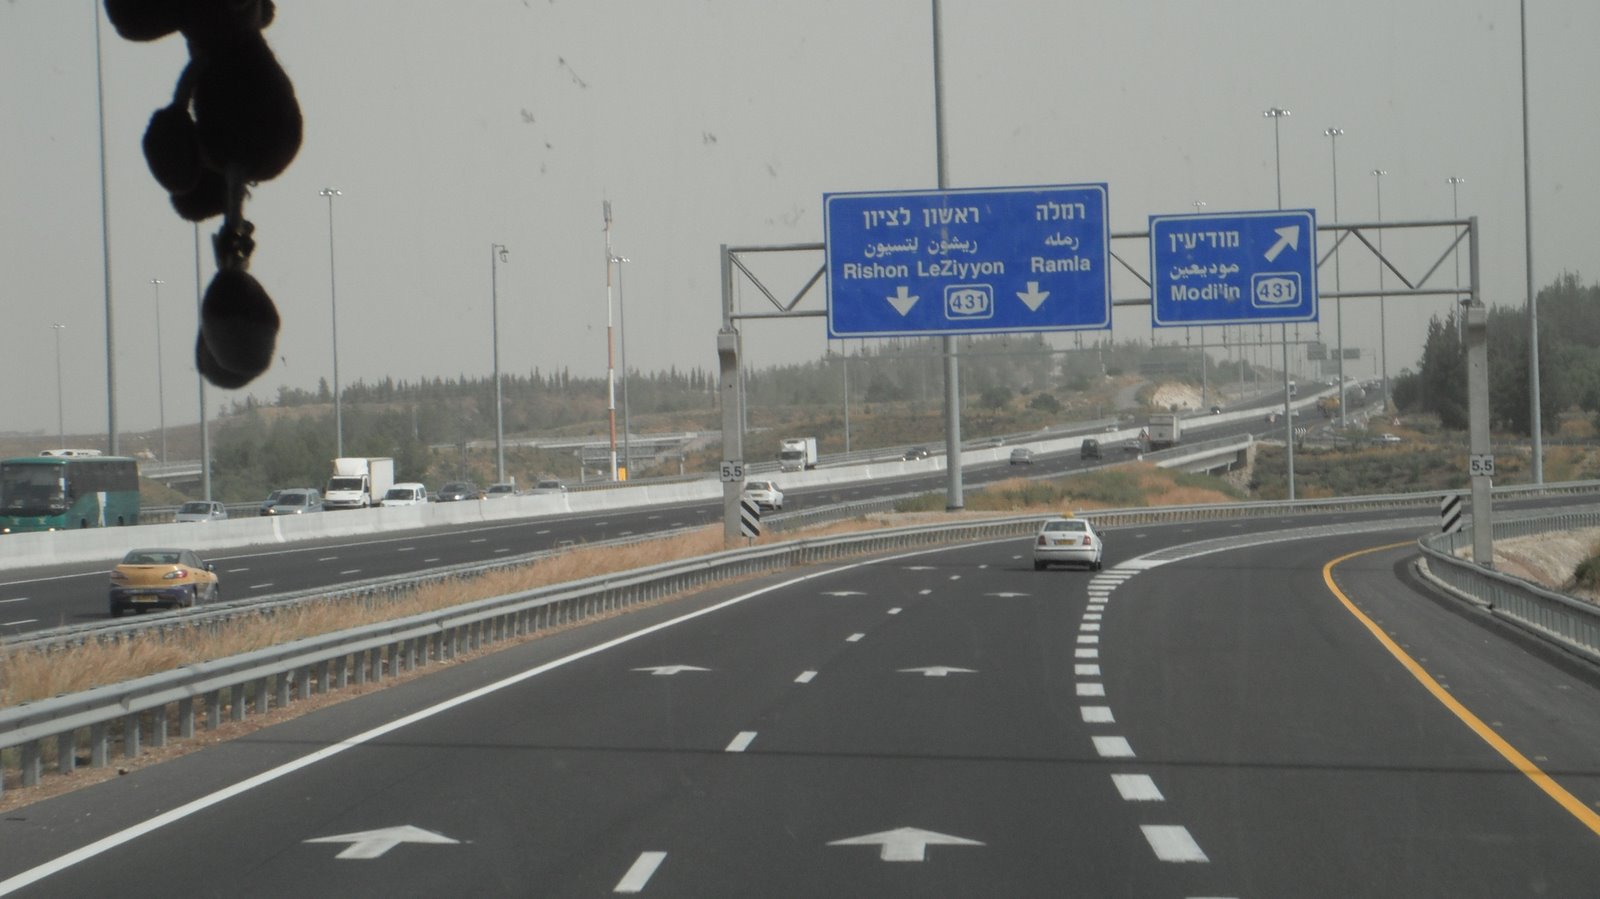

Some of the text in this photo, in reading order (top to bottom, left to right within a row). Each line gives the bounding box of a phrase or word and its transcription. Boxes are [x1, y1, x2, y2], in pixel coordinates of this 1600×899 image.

[863, 207, 980, 229] ראשון לציון
[1036, 202, 1086, 222] רמלה
[864, 237, 977, 258] ريشون لتسيون
[1045, 232, 1079, 250] رمله
[1169, 231, 1240, 252] מודיעין
[843, 259, 1004, 279] Rishon LeZiyyon
[1031, 255, 1091, 273] Ramla
[1170, 262, 1240, 280] موديعين
[1171, 284, 1240, 302] Modi'in
[1260, 283, 1292, 298] 431
[952, 294, 985, 310] 431
[722, 466, 742, 477] 5.5
[1472, 460, 1492, 471] 5.5
